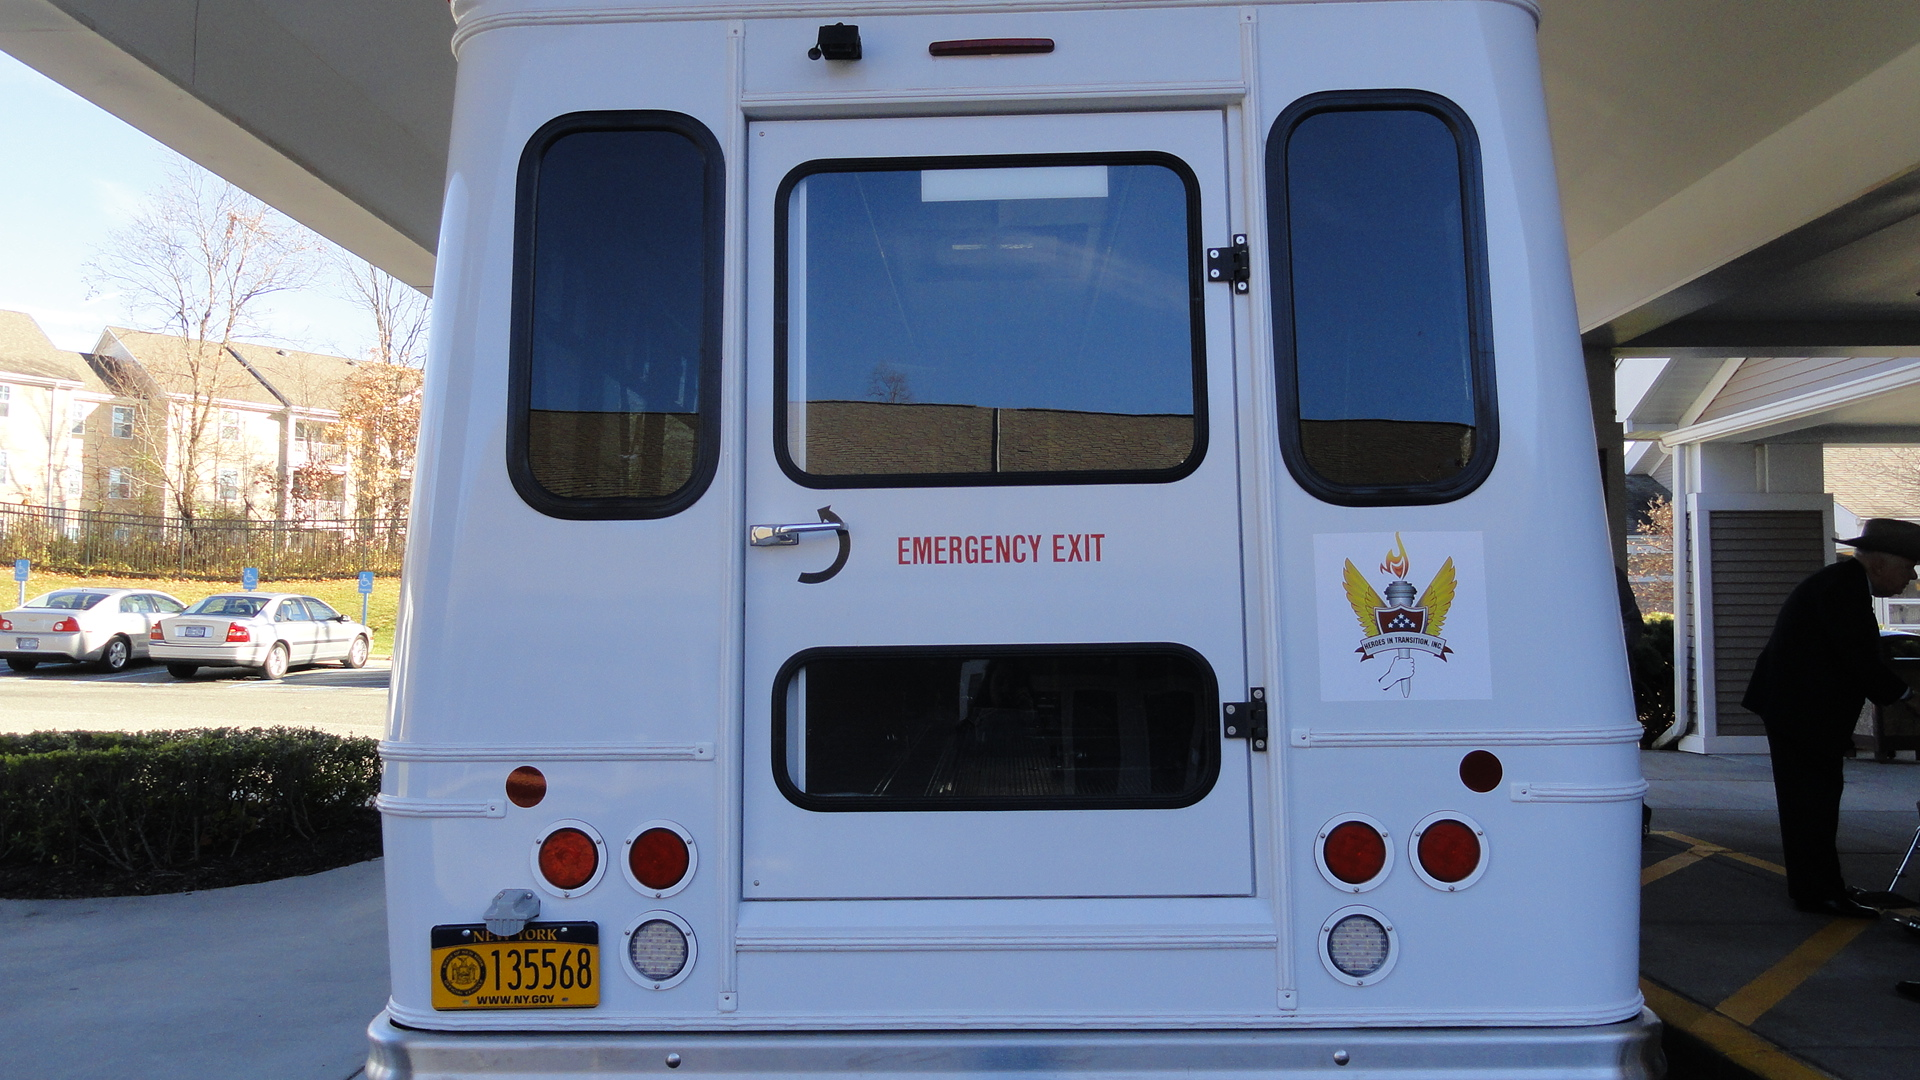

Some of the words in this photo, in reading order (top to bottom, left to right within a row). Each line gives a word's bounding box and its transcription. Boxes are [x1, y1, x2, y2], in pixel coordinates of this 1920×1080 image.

[898, 534, 1042, 565] EMERGENCY
[1053, 533, 1105, 562] EXIT
[1364, 638, 1386, 650] HEROES
[1395, 636, 1430, 646] TRANSITION,
[491, 948, 592, 990] 135568
[477, 995, 555, 1005] WWW.NY.GOV
